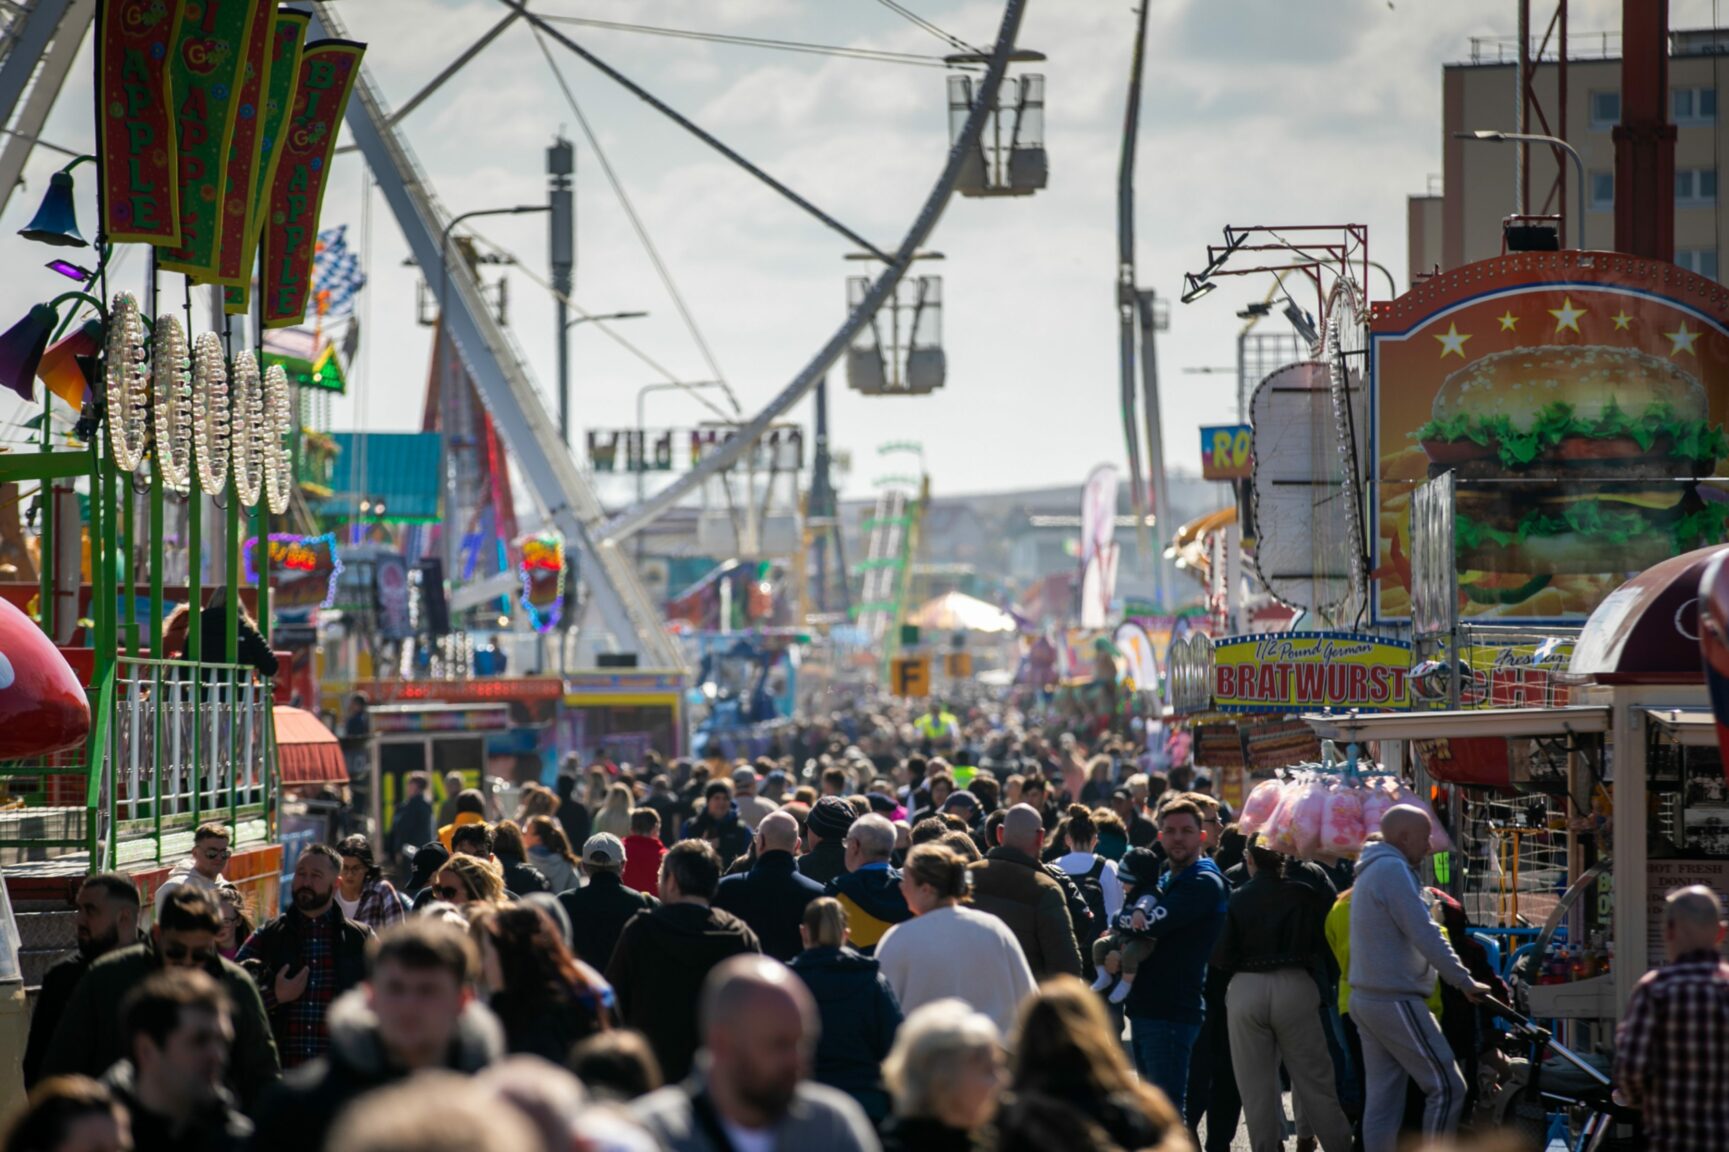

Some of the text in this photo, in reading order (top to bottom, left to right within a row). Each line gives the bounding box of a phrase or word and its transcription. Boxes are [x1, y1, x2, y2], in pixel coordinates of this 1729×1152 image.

[122, 50, 160, 229] APPLE
[276, 163, 309, 315] APPLE
[1255, 636, 1374, 666] 1/2 Pound German
[1216, 662, 1409, 704] BRATWURST
[1678, 863, 1723, 874] FRESH
